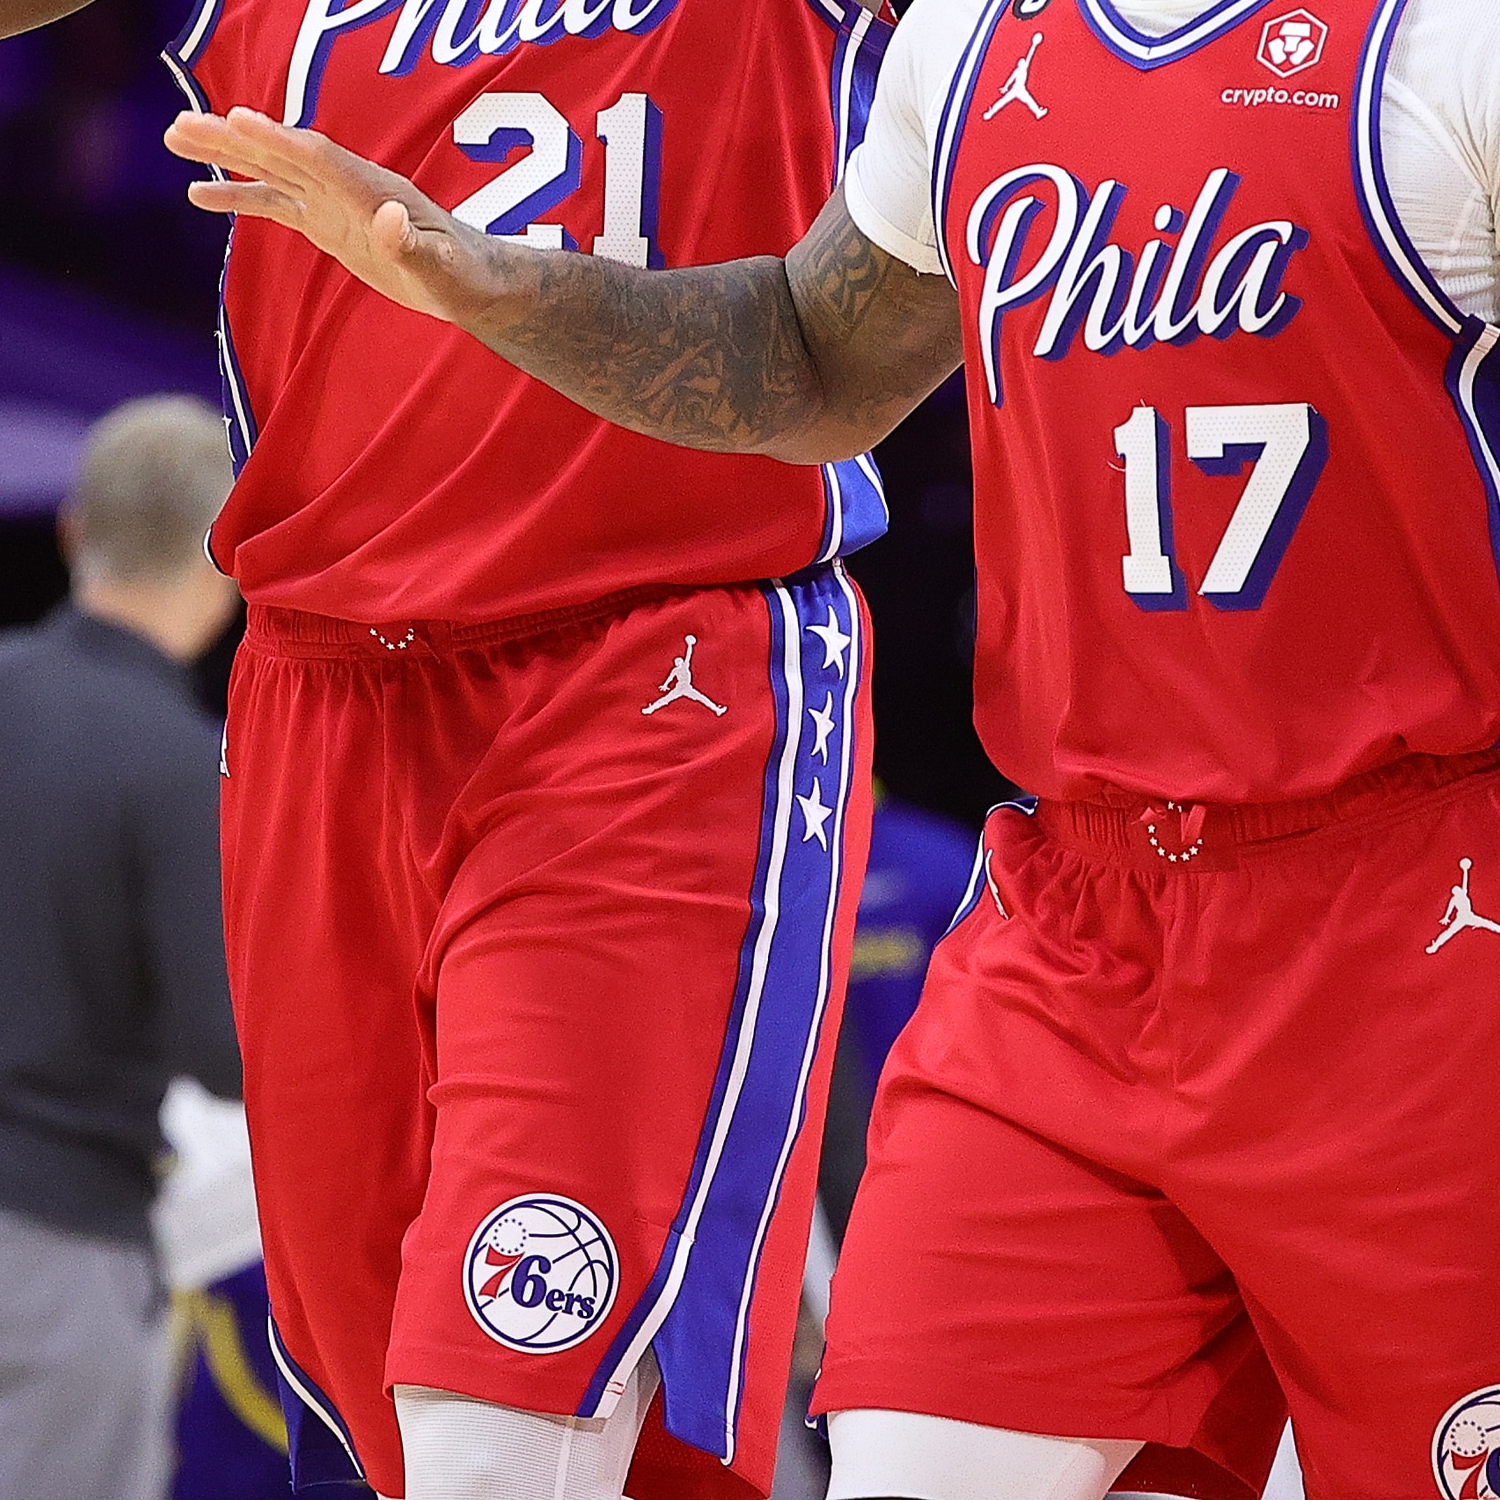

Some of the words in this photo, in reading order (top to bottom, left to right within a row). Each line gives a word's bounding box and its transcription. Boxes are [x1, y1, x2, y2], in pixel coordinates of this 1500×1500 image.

[450, 92, 658, 269] 21
[1221, 86, 1339, 109] crypto.com
[966, 163, 1304, 406] Phila
[1111, 403, 1324, 604] 17
[478, 1243, 597, 1320] 76ers
